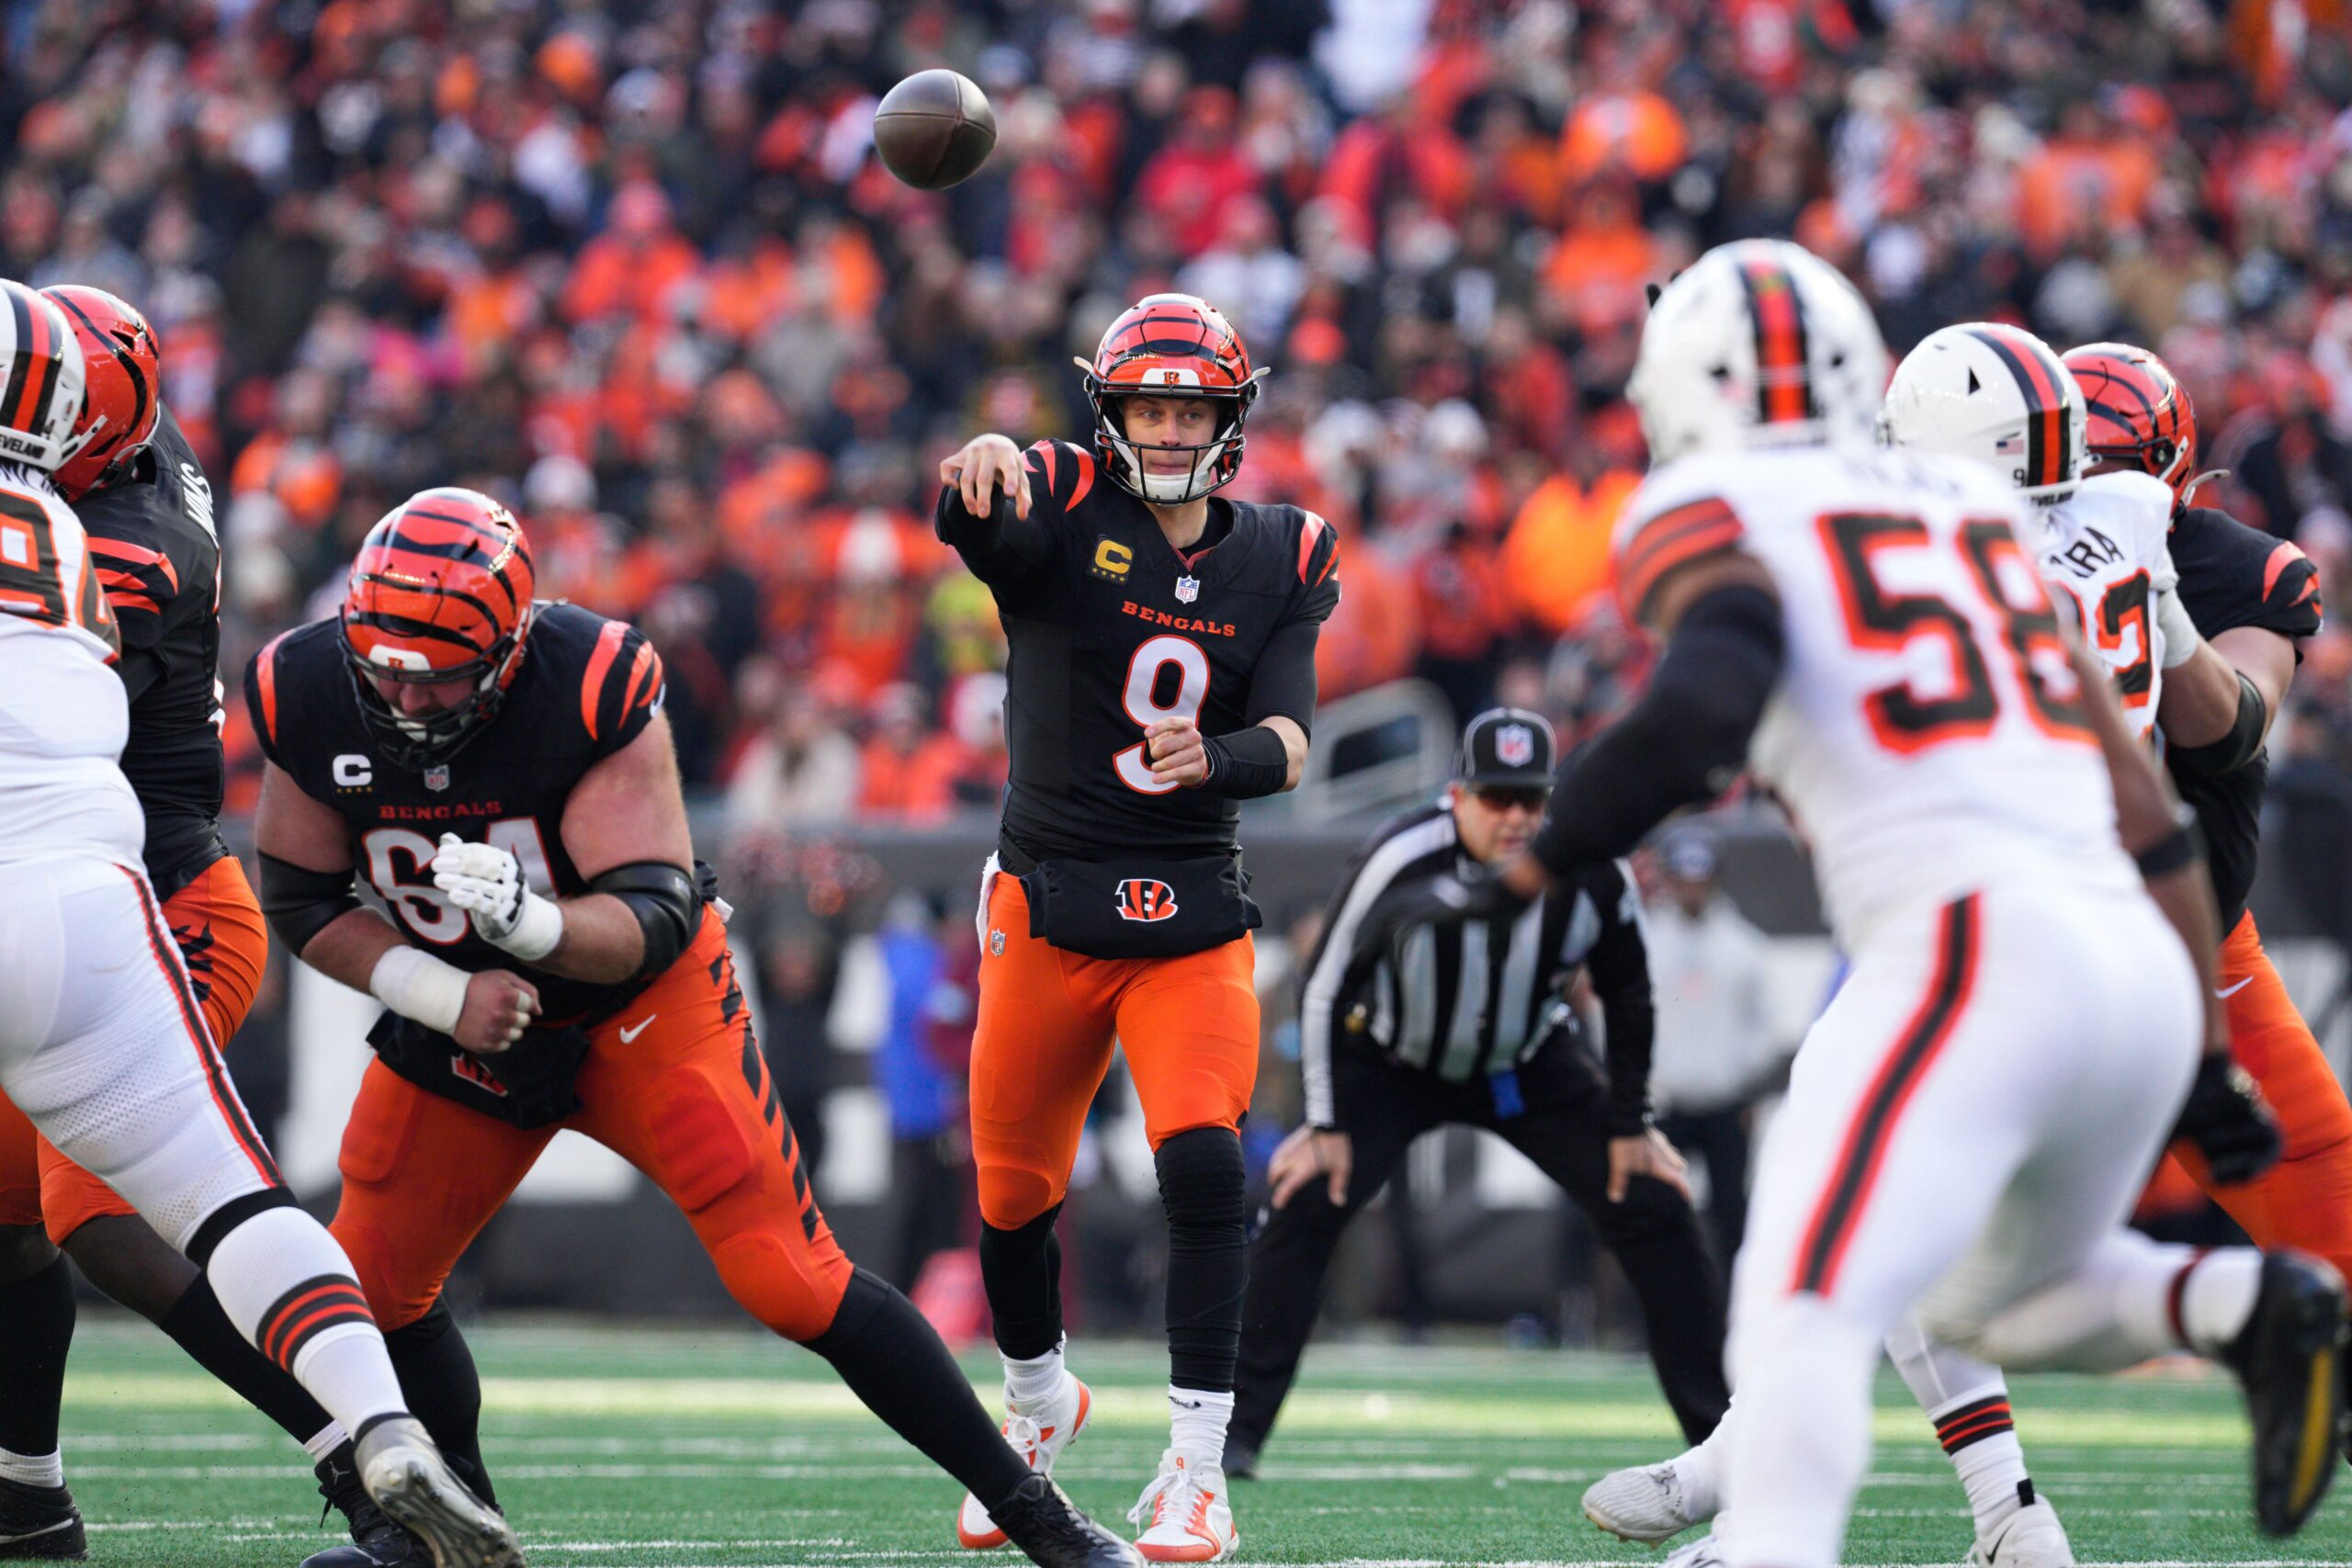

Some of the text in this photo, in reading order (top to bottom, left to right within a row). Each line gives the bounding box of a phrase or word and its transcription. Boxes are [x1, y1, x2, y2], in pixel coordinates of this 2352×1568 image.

[1095, 540, 1132, 573] C
[1122, 601, 1235, 637] BENGALS
[1815, 510, 2101, 761] 58
[1113, 634, 1211, 795] 9
[333, 754, 372, 785] C
[379, 801, 502, 819] BENGALS
[362, 816, 562, 944] 64
